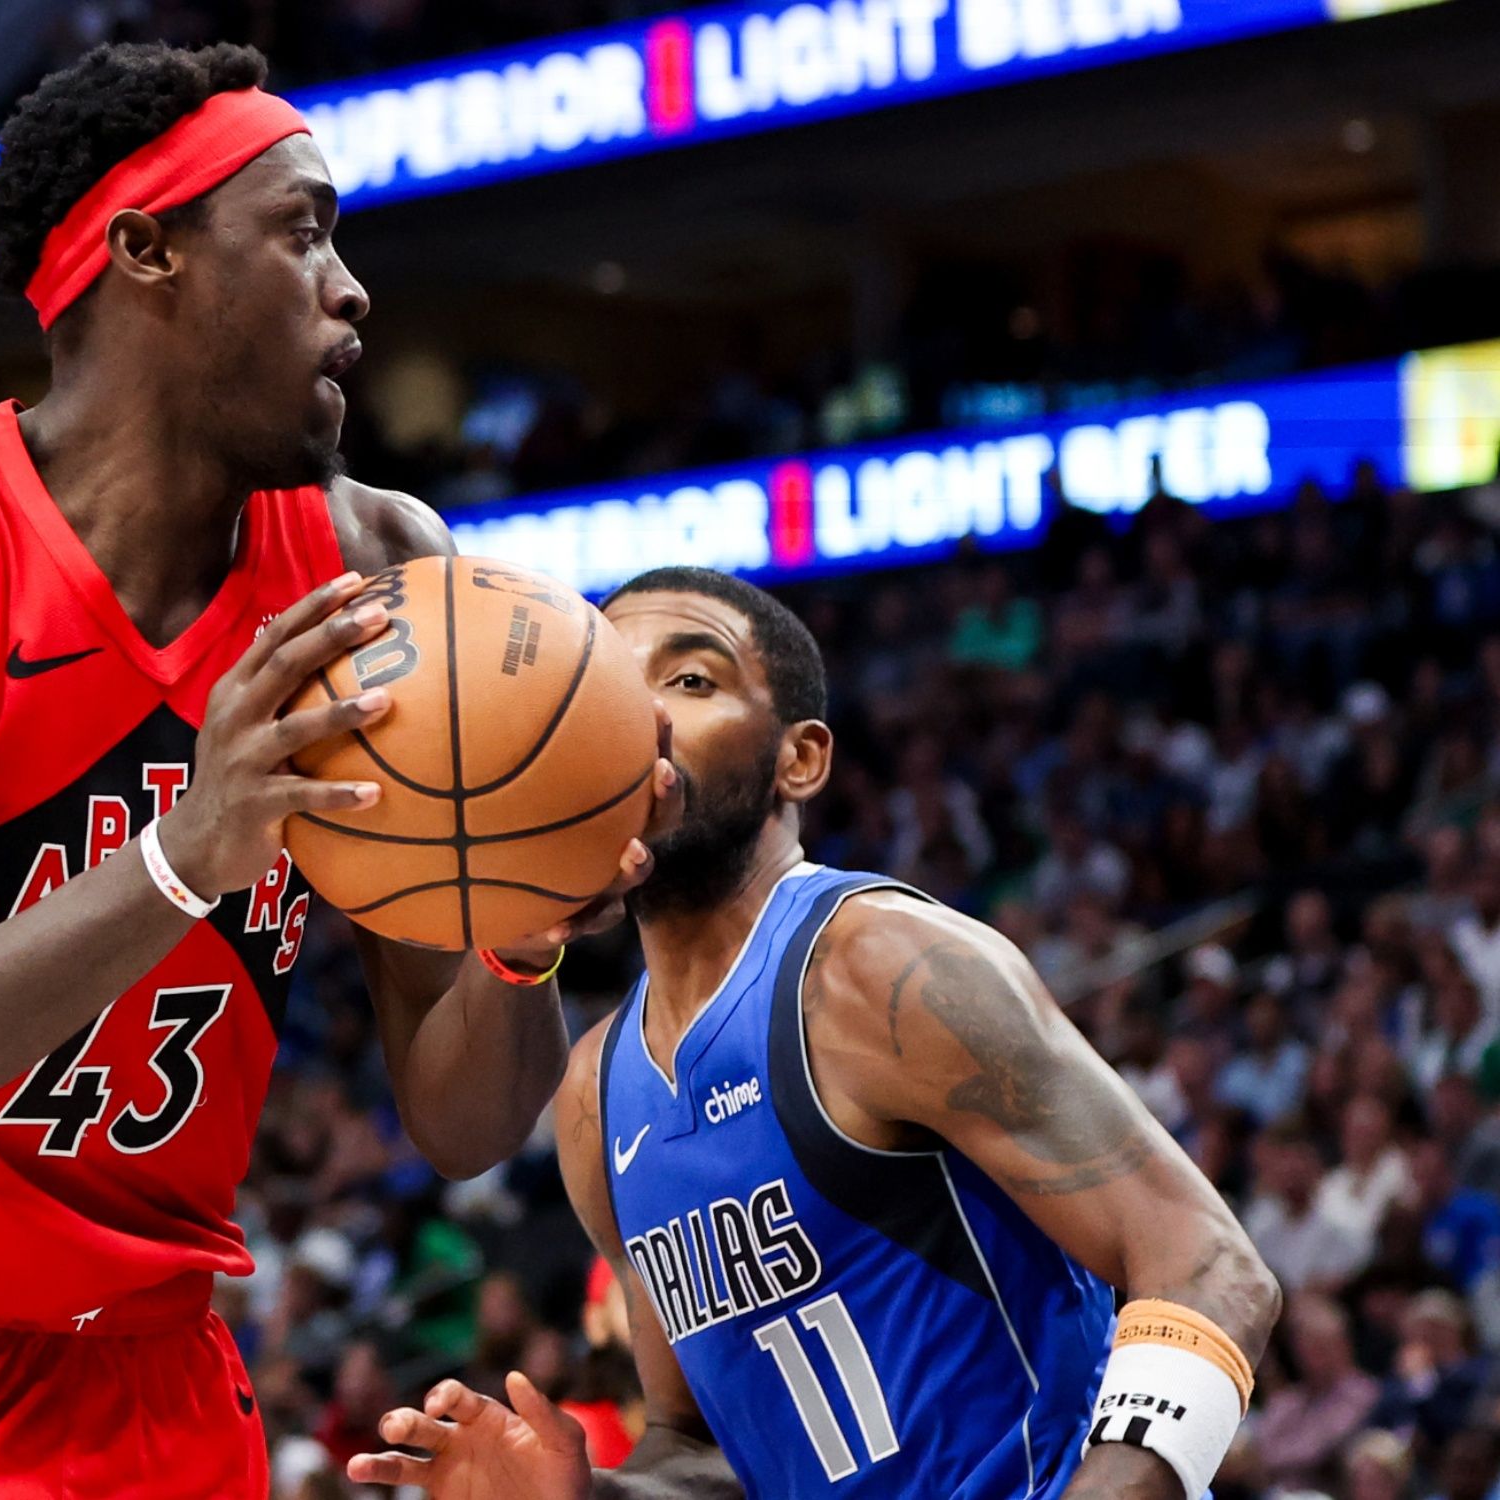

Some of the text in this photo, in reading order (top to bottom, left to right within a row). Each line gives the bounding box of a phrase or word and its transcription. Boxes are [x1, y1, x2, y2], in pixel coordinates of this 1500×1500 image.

[695, 0, 948, 121] LIGHT
[814, 433, 1055, 558] LIGHT
[705, 1076, 762, 1124] chime
[626, 1178, 822, 1345] DALLAS
[753, 1291, 900, 1483] 11
